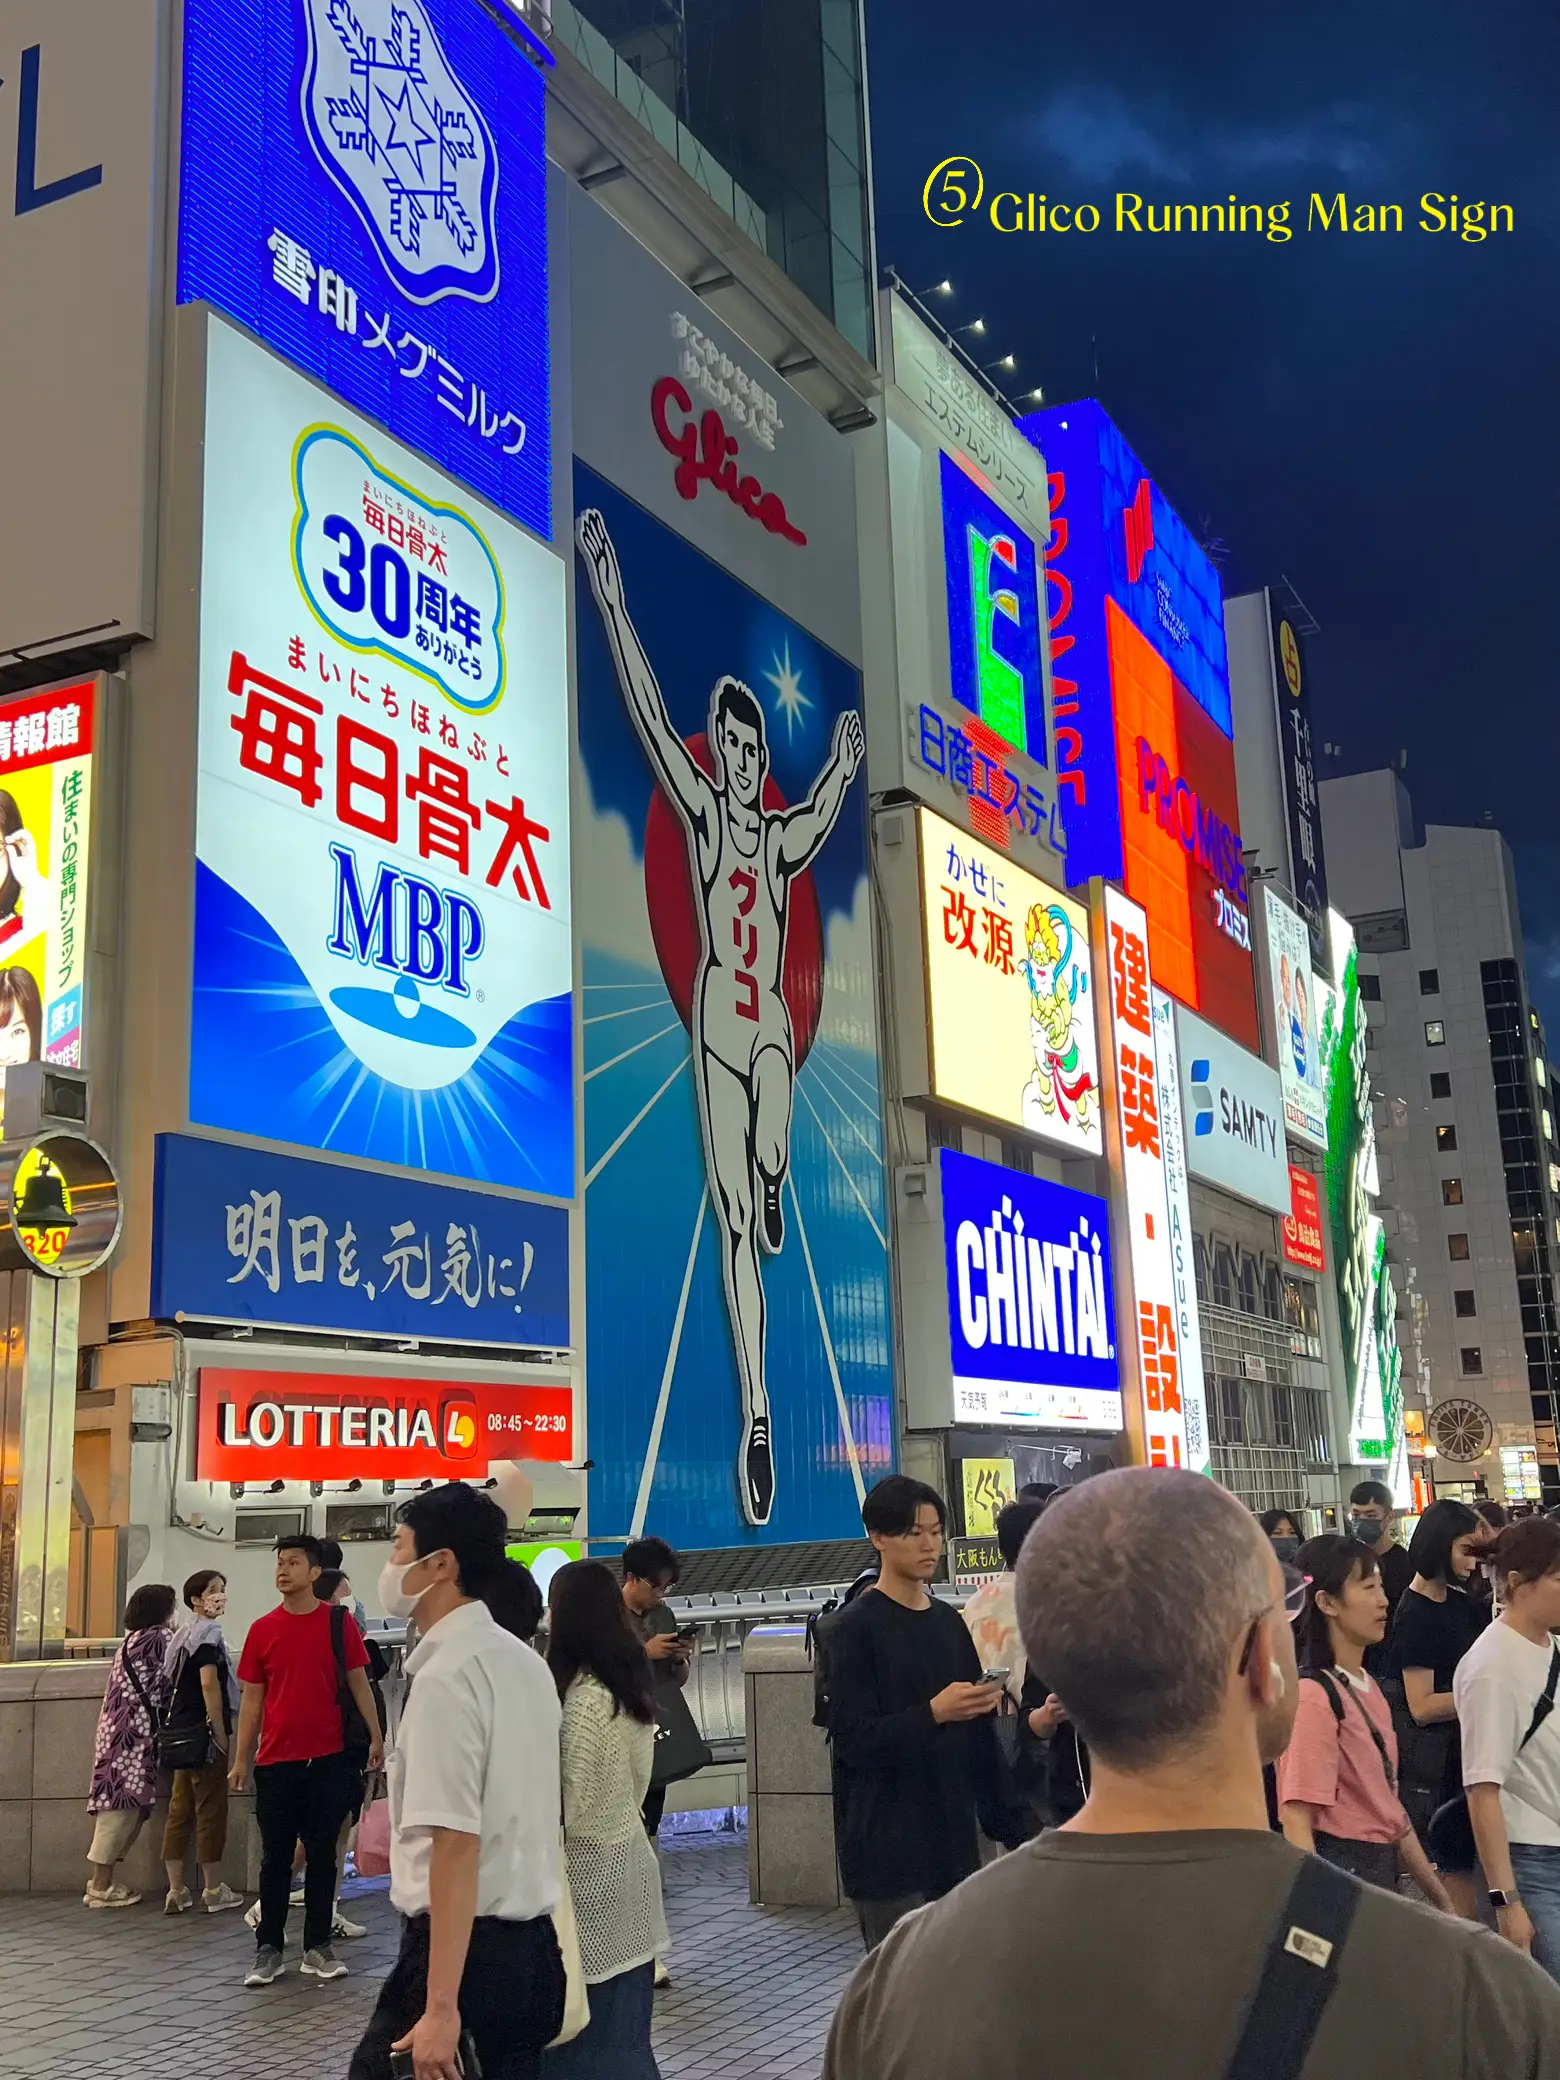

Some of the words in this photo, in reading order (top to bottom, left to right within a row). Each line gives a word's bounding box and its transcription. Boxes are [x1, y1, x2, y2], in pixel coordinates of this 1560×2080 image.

[267, 226, 527, 456] 雪印メグミルク
[362, 494, 448, 577] 毎日骨太
[363, 480, 448, 544] まいにちほねぶと
[650, 375, 808, 547] Glico
[287, 634, 510, 778] まいにちほねぶと
[415, 623, 482, 681] ありがとう
[227, 649, 551, 910] 毎日骨太
[1135, 736, 1248, 903] PROMISE
[58, 769, 83, 988] 住まいの専門ショップ
[327, 840, 485, 996] MBP
[728, 865, 760, 1023] グリコ
[940, 884, 1016, 976] 改源
[1210, 888, 1252, 952] プロミス
[1220, 1087, 1277, 1159] SAMTY
[955, 1194, 1109, 1361] CHINTAI
[224, 1401, 437, 1448] LOTTERIA
